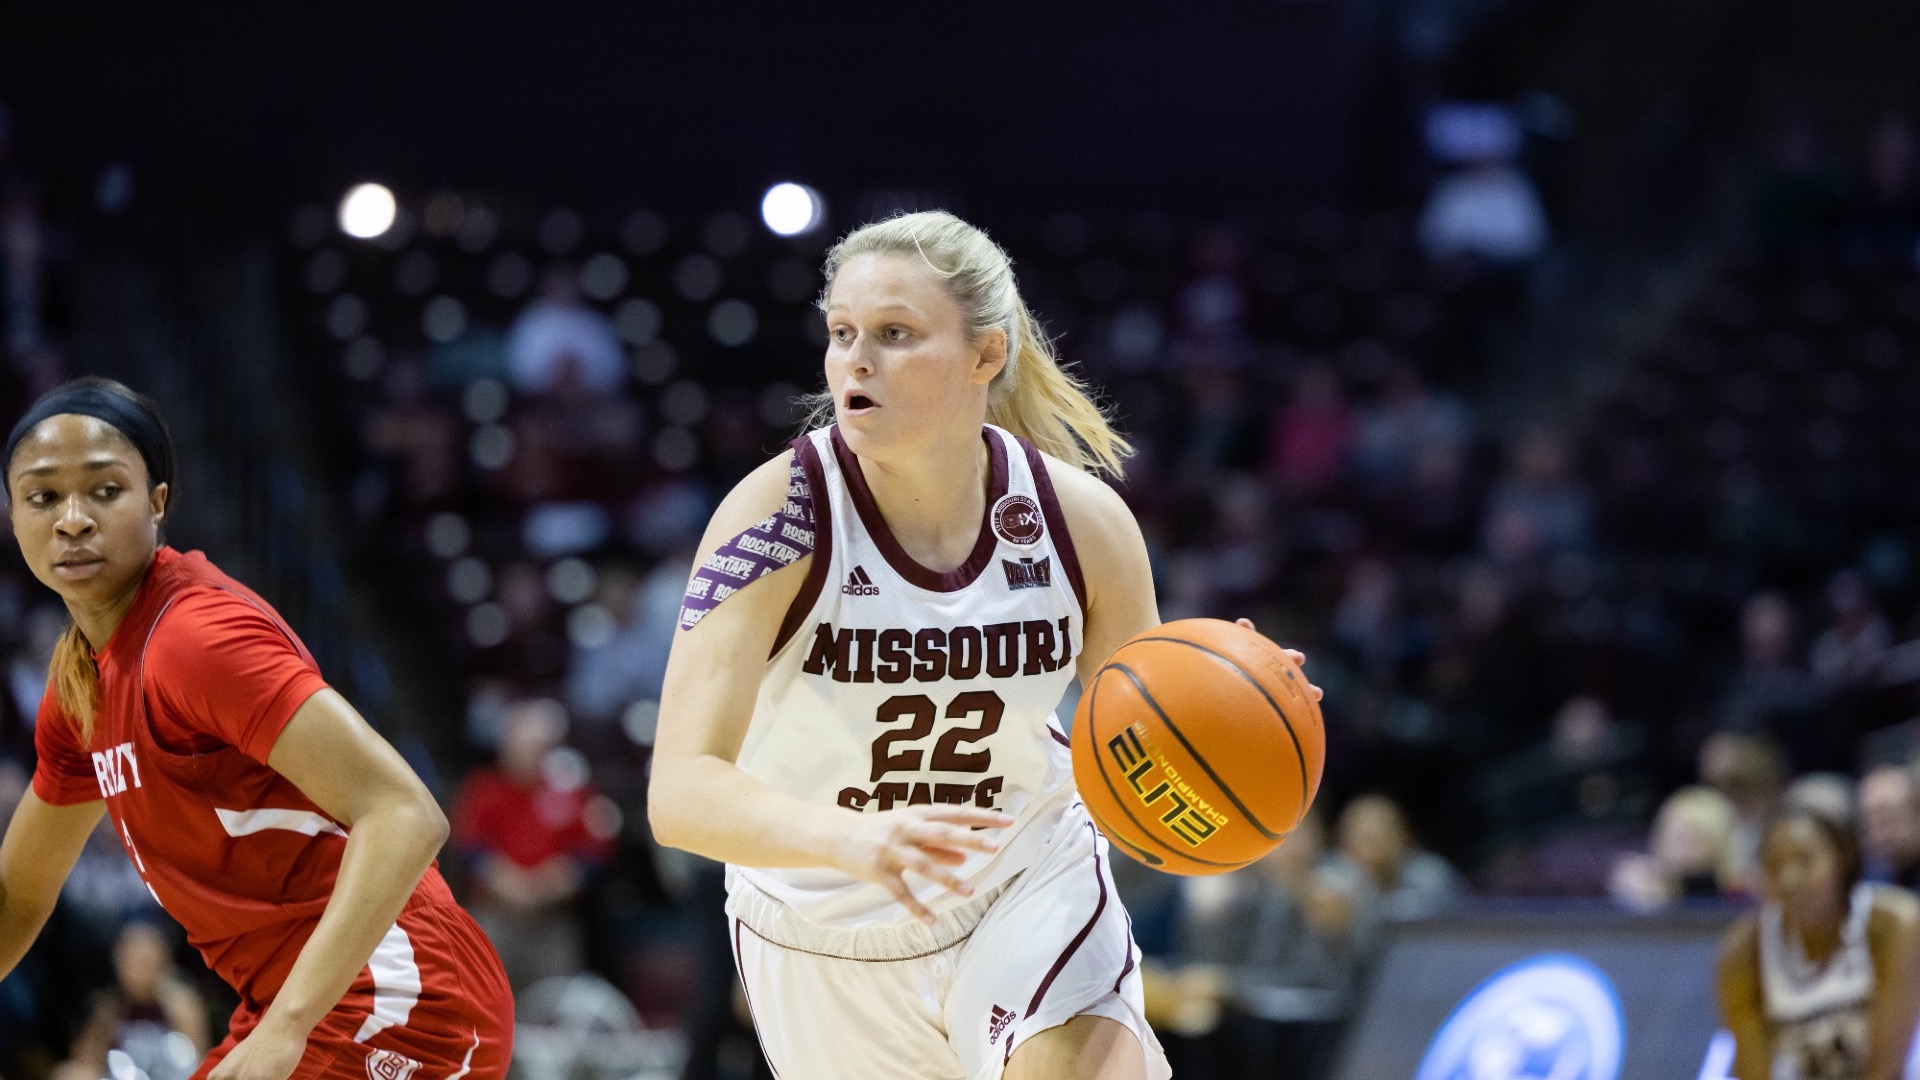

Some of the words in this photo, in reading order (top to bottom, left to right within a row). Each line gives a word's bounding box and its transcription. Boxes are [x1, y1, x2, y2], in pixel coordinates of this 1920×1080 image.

[841, 584, 880, 596] aidas
[802, 616, 1072, 684] MISSOURI
[869, 690, 1006, 782] 22
[1133, 719, 1230, 827] CHAMPIONIP
[1107, 725, 1220, 849] ELITE
